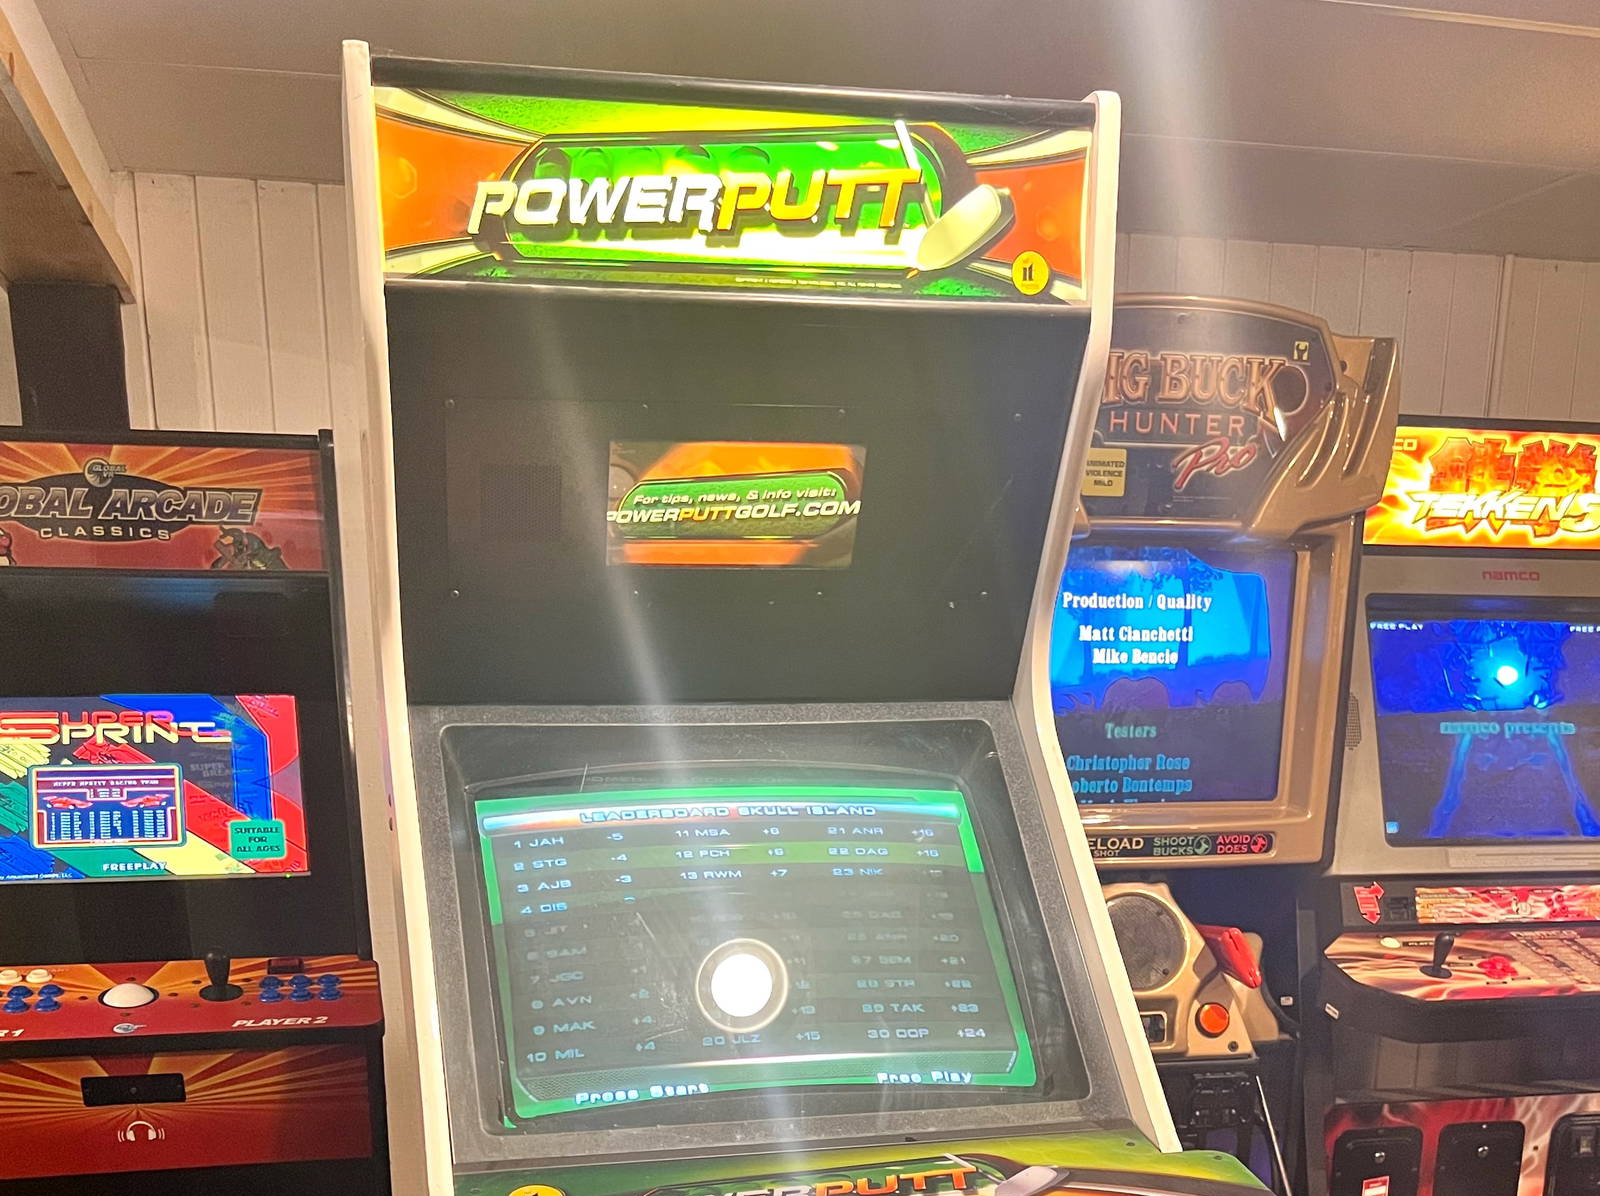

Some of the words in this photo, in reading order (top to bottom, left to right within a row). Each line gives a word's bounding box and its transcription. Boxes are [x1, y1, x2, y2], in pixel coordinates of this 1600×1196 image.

[467, 168, 922, 235] POWERPUTT
[1157, 353, 1286, 429] BUCK
[1109, 410, 1245, 436] HUNTER
[92, 464, 127, 473] GLOBAL
[1171, 436, 1258, 490] Pro
[633, 495, 658, 505] For
[661, 493, 694, 505] tips,
[697, 491, 742, 503] news,
[746, 490, 760, 500] &
[762, 488, 791, 501] info
[796, 487, 837, 499] visit:
[98, 488, 259, 522] ARCADE
[606, 500, 862, 525] POWERPUTTGOLF.COM
[1405, 490, 1579, 525] TEKKEN
[1560, 491, 1600, 532] 5
[40, 525, 171, 540] CLASSICS
[1483, 570, 1540, 581] namco
[1062, 591, 1144, 609] Production
[1156, 593, 1213, 612] Quality
[1079, 624, 1115, 642] Matt
[1370, 622, 1396, 630] FREE
[1398, 623, 1423, 631] PLAY
[1092, 648, 1128, 665] Mike
[1105, 722, 1157, 739] Testers
[1066, 754, 1153, 773] Christopher
[1155, 753, 1191, 771] Rose
[580, 807, 730, 823] LEADERBOARD
[738, 805, 800, 817] SKULL
[806, 805, 876, 816] ISLAND
[675, 829, 690, 838] 11
[695, 828, 730, 837] MSA
[827, 827, 846, 835] 21
[513, 840, 522, 849] 1
[529, 835, 564, 848] JAH
[607, 832, 624, 841] -5
[1153, 836, 1194, 846] SHOOT
[1216, 835, 1250, 845] AVOID
[1153, 847, 1194, 856] BUCKS
[1216, 845, 1248, 854] DOES
[102, 861, 167, 871] FREEPLAY
[513, 862, 525, 871] 2
[532, 858, 568, 870] STG
[610, 853, 628, 862] -4
[680, 871, 698, 880] 13
[703, 868, 742, 879] RWM
[770, 868, 788, 877] +7
[832, 868, 854, 876] 23
[516, 883, 529, 893] 3
[615, 875, 633, 884] -3
[520, 905, 533, 915] 4
[552, 995, 592, 1007] AVN
[890, 1003, 925, 1013] TAK
[232, 1016, 313, 1028] PLAYER
[315, 1016, 329, 1025] 2
[553, 1020, 596, 1033] MAK
[867, 1029, 890, 1039] 30
[957, 1028, 986, 1038] +24
[527, 1052, 547, 1063] 10
[555, 1048, 585, 1060] MIL
[876, 1071, 922, 1084] Free
[930, 1070, 973, 1084] Play
[575, 1089, 640, 1105] Press
